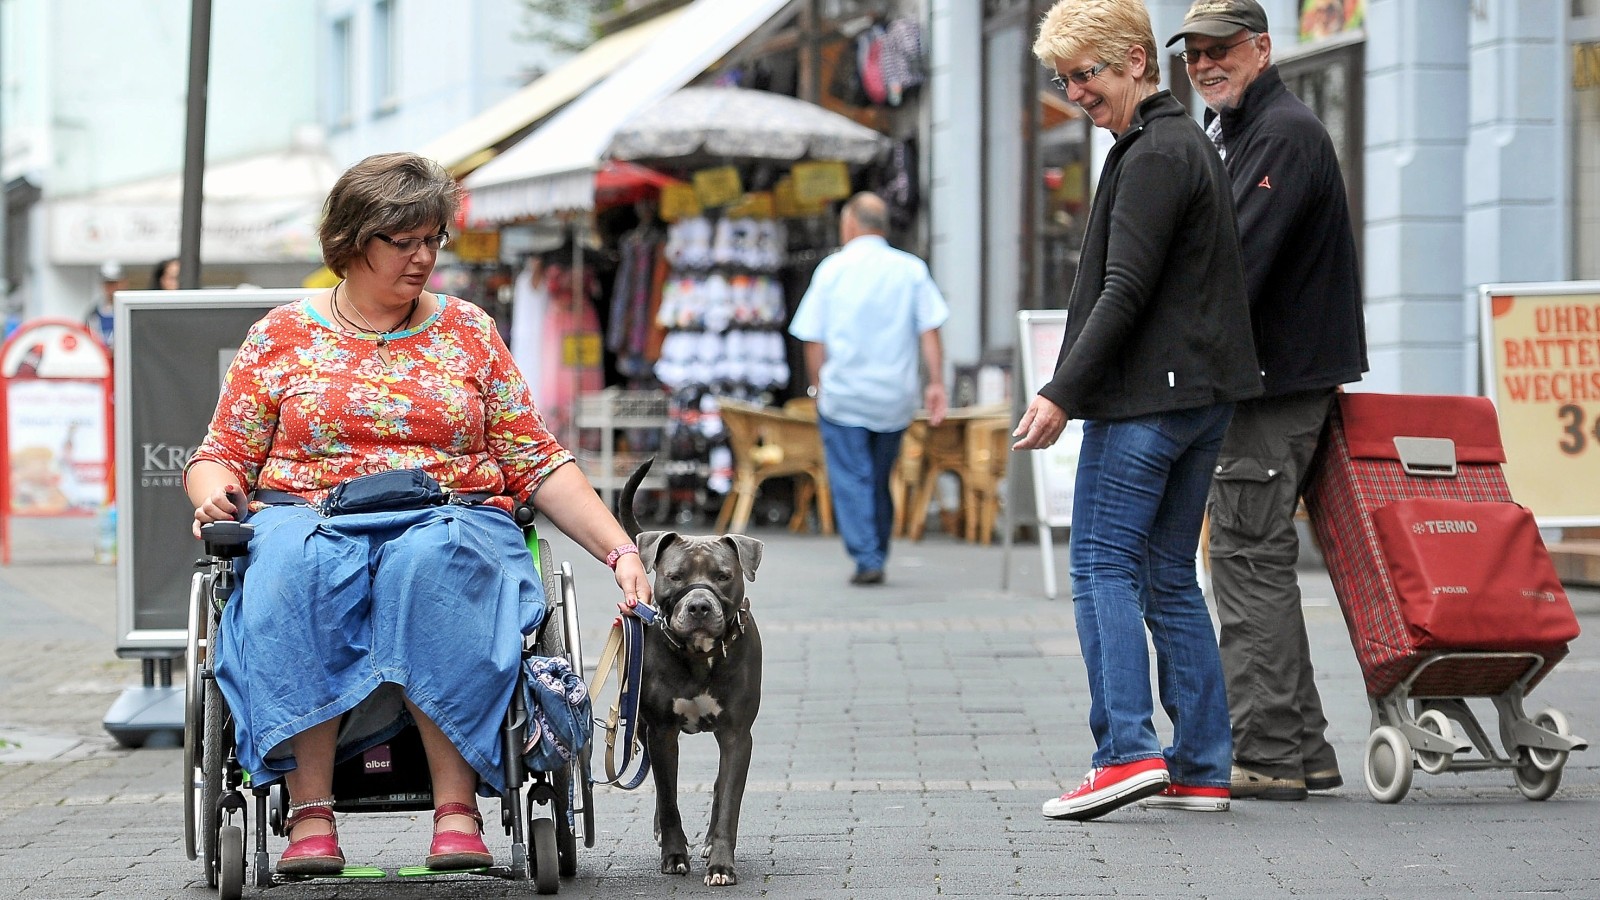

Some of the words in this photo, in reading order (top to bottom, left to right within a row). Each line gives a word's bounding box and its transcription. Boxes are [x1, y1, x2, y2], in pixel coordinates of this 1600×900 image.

[1503, 337, 1600, 369] BATTE
[1425, 519, 1478, 534] TERMO
[365, 760, 390, 768] alber
